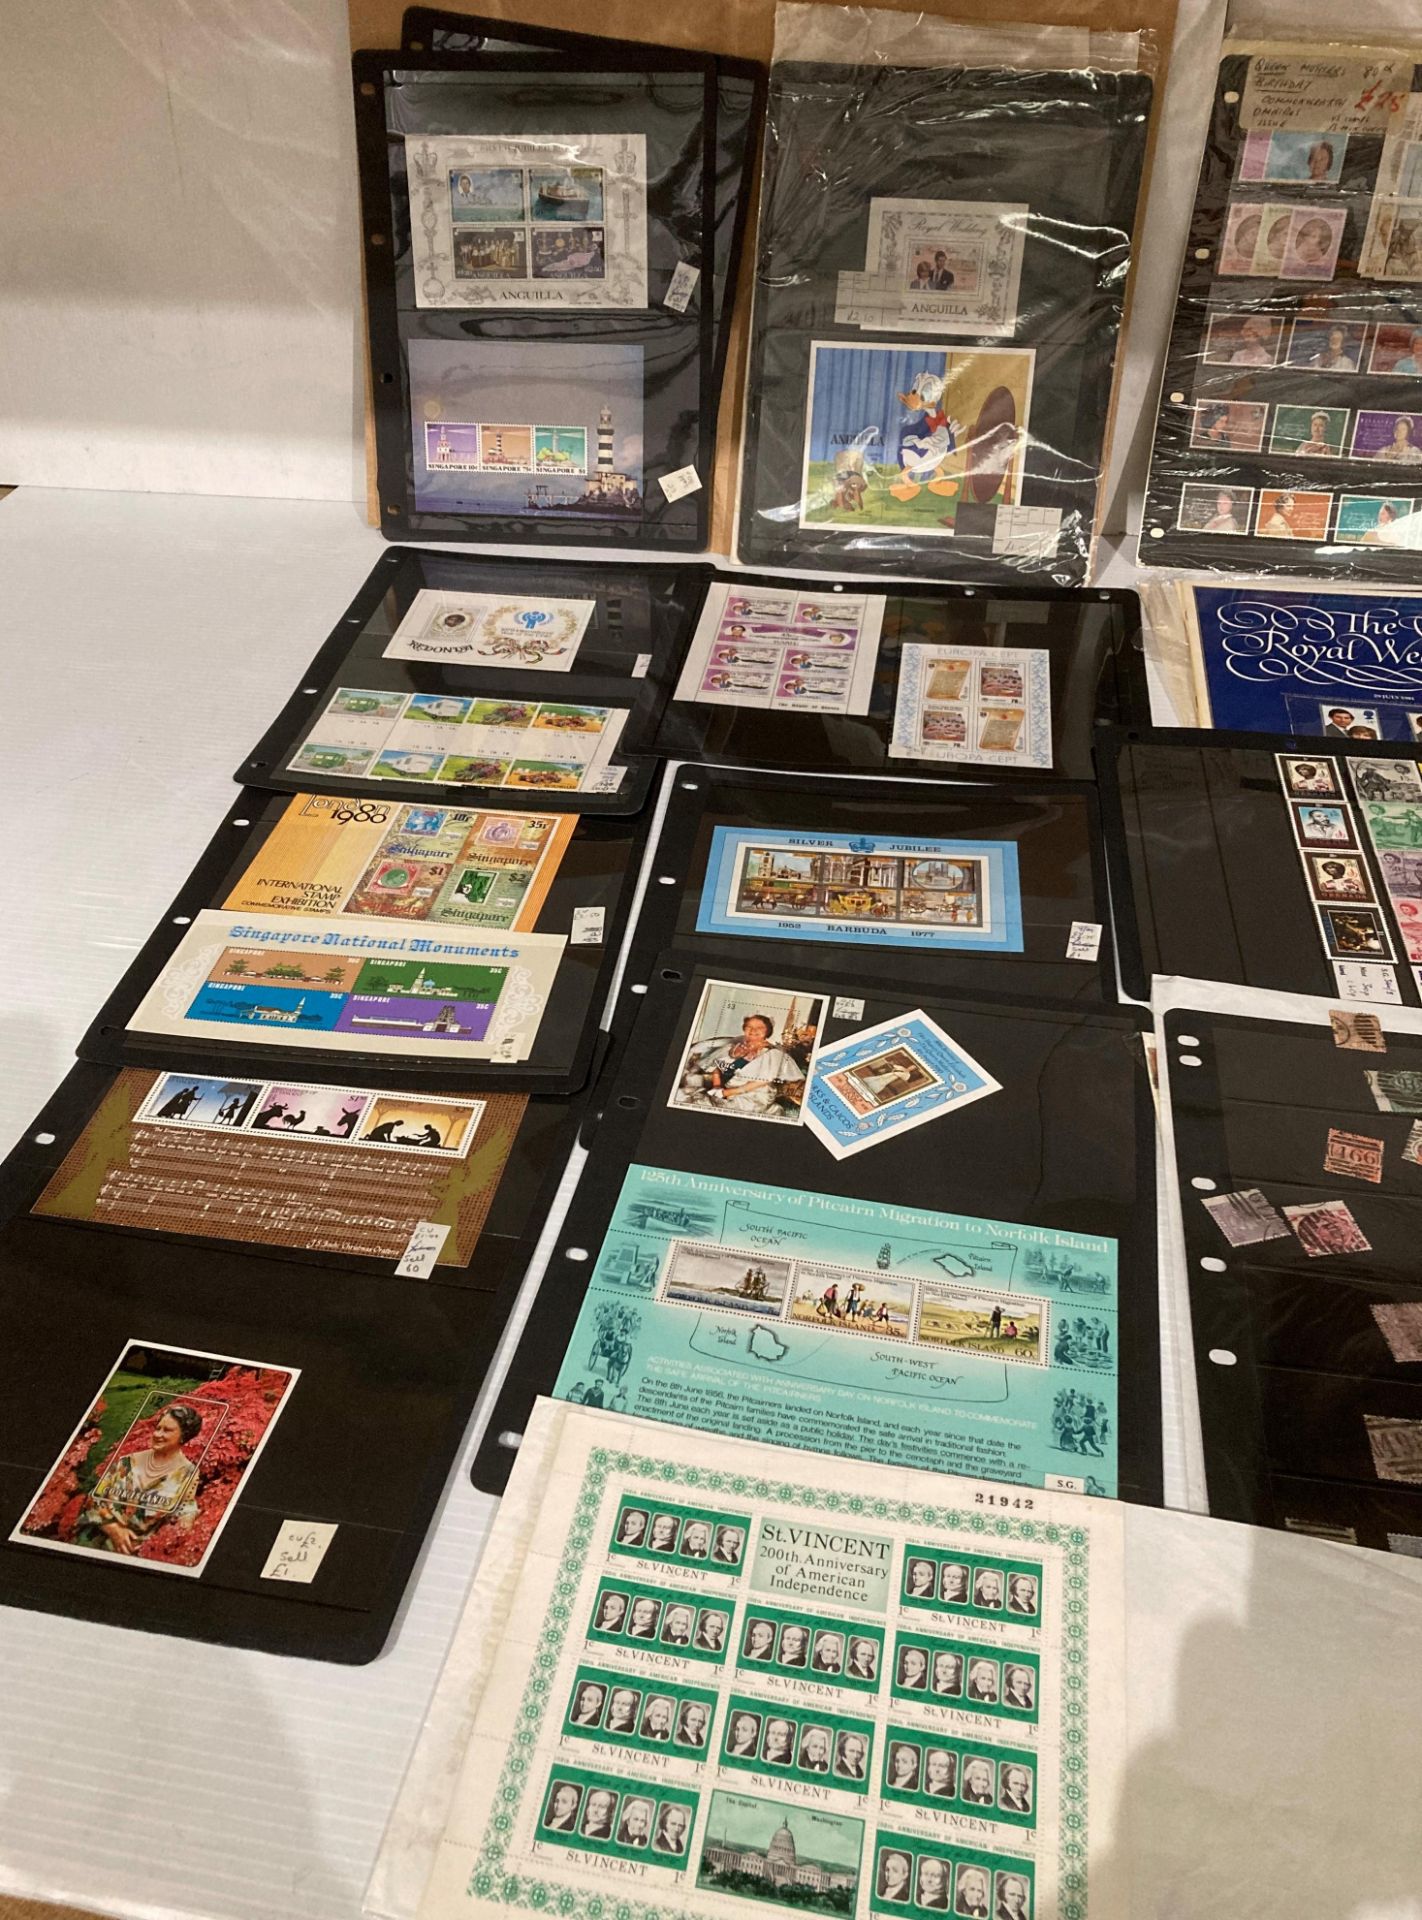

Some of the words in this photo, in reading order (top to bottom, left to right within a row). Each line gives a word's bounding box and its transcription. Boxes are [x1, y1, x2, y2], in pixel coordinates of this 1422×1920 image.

[501, 291, 563, 300] ANGUILLA
[912, 303, 968, 316] ANGUILLA
[937, 648, 985, 657] EUROPA
[329, 803, 388, 825] 1980
[788, 838, 834, 847] SILVER
[889, 844, 942, 853] JUBILEE
[466, 852, 533, 867] Singapore
[428, 866, 445, 876] $1
[509, 872, 527, 883] $2
[256, 878, 343, 893] INTERNATIONAL
[271, 894, 337, 909] EXHIBITION
[303, 890, 341, 901] STAMP
[240, 900, 302, 912] COMMEMORATIVE
[440, 907, 511, 923] Singapore
[827, 924, 888, 935] BARBUDA
[911, 930, 936, 938] 1977
[229, 924, 320, 945] Singapore
[320, 931, 406, 951] National
[409, 938, 520, 959] Monuments
[370, 959, 407, 968] SINGAPORE
[208, 981, 247, 992] SINGAPORE
[826, 1102, 855, 1129] CAICOS
[640, 1169, 682, 1186] 125th
[684, 1176, 786, 1205] Anniversary
[787, 1195, 807, 1207] of
[807, 1196, 875, 1217] Pitcairn
[878, 1207, 959, 1231] Migration
[965, 1220, 982, 1233] to
[985, 1222, 1050, 1246] Norfolk
[1055, 1233, 1109, 1254] Island
[738, 1222, 773, 1235] SOUTH
[774, 1228, 808, 1241] PACIFIC
[750, 1235, 784, 1248] OCEAN
[792, 1312, 837, 1327] NORFOLK
[838, 1320, 878, 1332] ISLAND
[710, 1325, 737, 1337] Norfolk
[920, 1334, 965, 1350] NORFOLK
[966, 1342, 1005, 1354] ISLAND
[885, 1367, 927, 1381] PACIFIC
[928, 1373, 962, 1389] OCEAN
[638, 1386, 688, 1401] descendants
[700, 1397, 713, 1406] the
[715, 1400, 744, 1411] Pitcairn
[746, 1405, 775, 1417] families
[777, 1412, 796, 1421] have
[798, 1415, 861, 1433] commemorated
[863, 1425, 876, 1435] the
[878, 1428, 896, 1438] safe
[897, 1432, 923, 1443] arrival
[934, 1439, 974, 1452] traditional
[641, 1376, 653, 1385] On
[655, 1379, 667, 1388] the
[669, 1381, 683, 1391] 8th
[683, 1383, 703, 1395] June
[727, 1392, 740, 1401] the
[741, 1395, 782, 1409] Pitcairners
[785, 1402, 812, 1415] landed
[813, 1408, 824, 1417] on
[825, 1410, 855, 1422] Norfolk
[883, 1421, 900, 1430] and
[900, 1424, 921, 1434] each
[923, 1429, 942, 1437] year
[944, 1431, 966, 1441] since
[968, 1435, 985, 1445] that
[986, 1438, 1005, 1448] date
[1007, 1441, 1022, 1450] the
[637, 1393, 652, 1404] The
[654, 1397, 667, 1406] 8th
[669, 1400, 689, 1411] June
[690, 1405, 711, 1415] each
[712, 1410, 730, 1418] year
[732, 1412, 740, 1420] is
[741, 1414, 755, 1423] set
[756, 1417, 778, 1427] aside
[780, 1422, 791, 1430] as
[800, 1424, 825, 1436] public
[859, 1434, 874, 1443] The
[901, 1442, 938, 1456] festivities
[940, 1448, 986, 1463] commence
[988, 1457, 1006, 1467] with
[1008, 1460, 1015, 1468] a
[633, 1404, 678, 1417] enactment
[676, 1411, 685, 1419] of
[686, 1413, 699, 1422] the
[700, 1415, 730, 1428] original
[765, 1427, 773, 1435] A
[775, 1430, 821, 1443] procession
[823, 1438, 842, 1448] from
[844, 1441, 858, 1451] the
[859, 1444, 876, 1455] pier
[878, 1448, 887, 1456] to
[889, 1449, 903, 1459] the
[905, 1452, 945, 1467] cenotaph
[946, 1460, 963, 1470] and
[965, 1462, 979, 1472] the
[980, 1465, 1022, 1479] graveyard
[1056, 1479, 1077, 1490] S.G.
[130, 1491, 172, 1506] ISLANDS
[974, 1492, 1035, 1510] 21942
[804, 1553, 889, 1580] Anniversary
[775, 1564, 792, 1576] of
[795, 1567, 866, 1589] American
[769, 1574, 869, 1602] Independence
[811, 1815, 843, 1827] Washington
